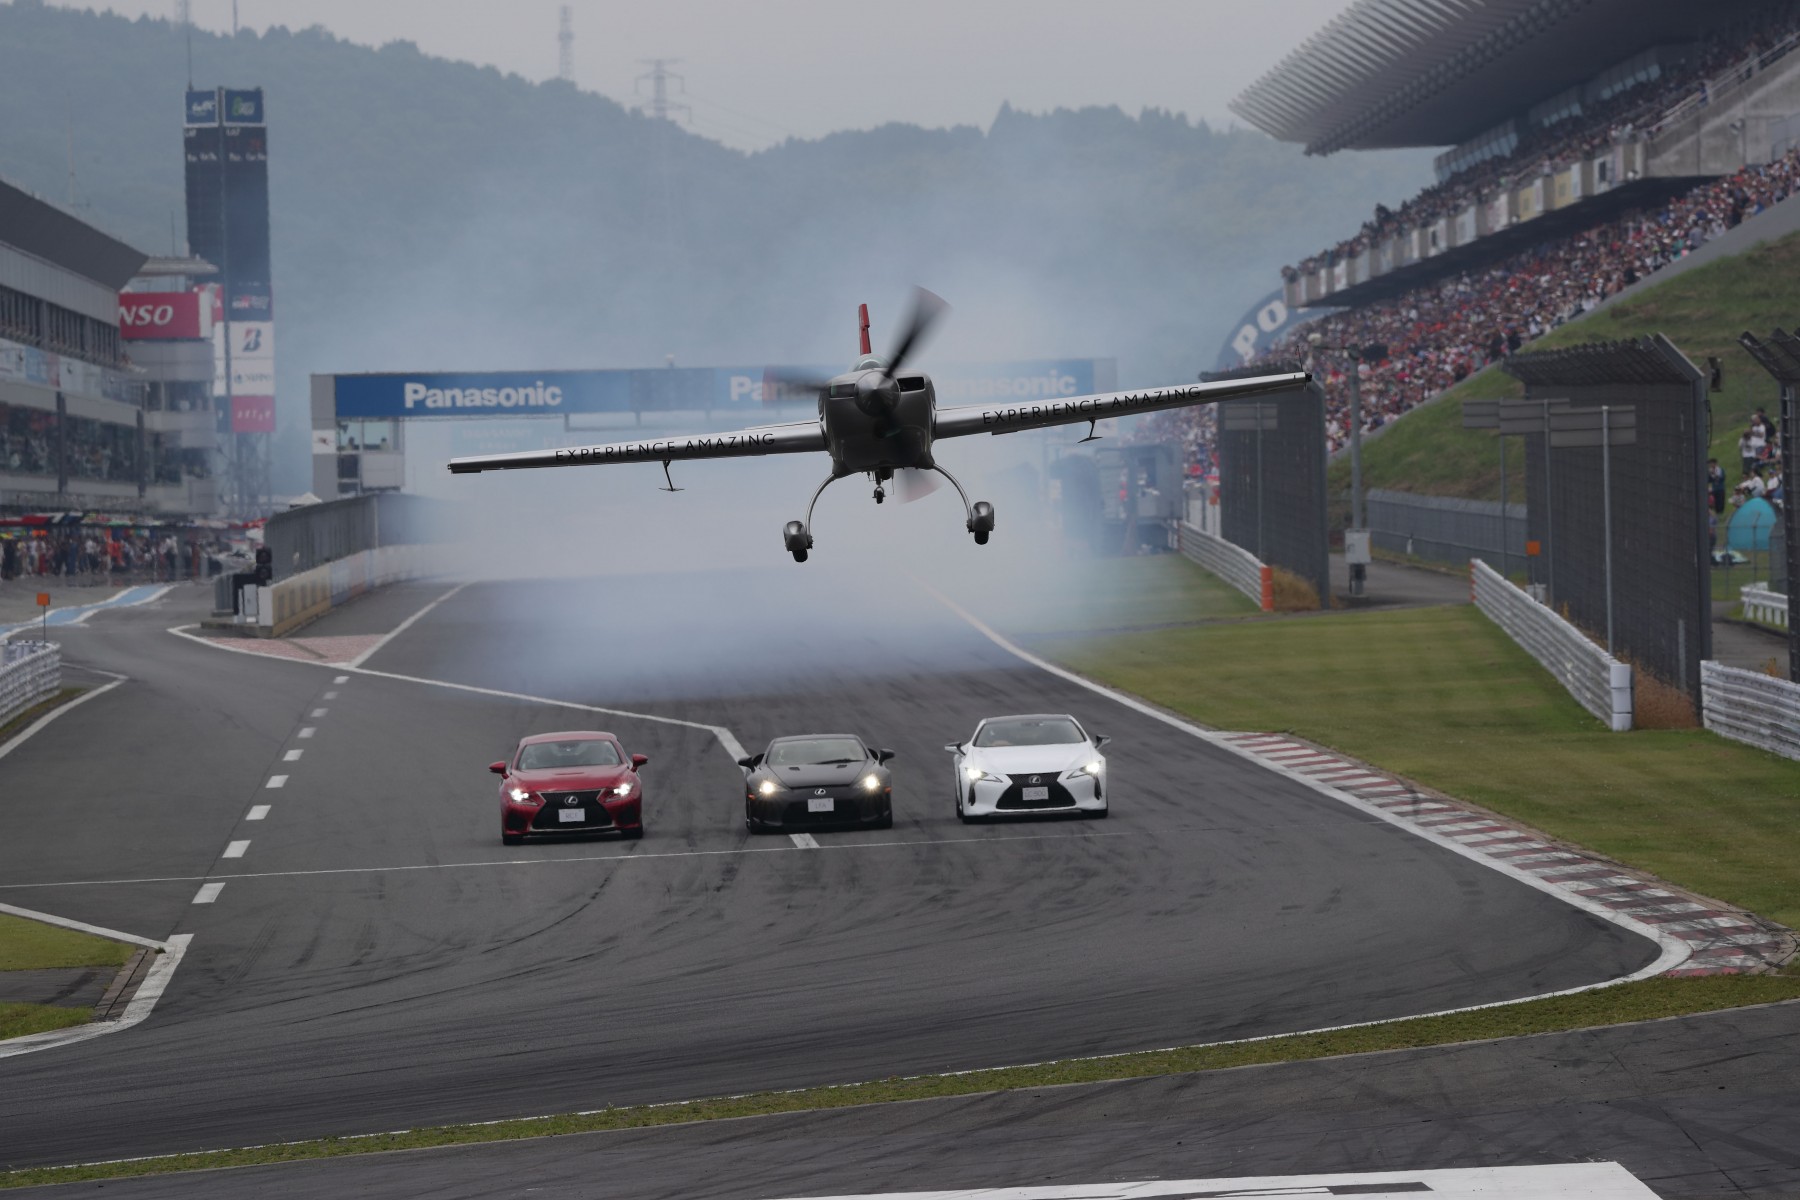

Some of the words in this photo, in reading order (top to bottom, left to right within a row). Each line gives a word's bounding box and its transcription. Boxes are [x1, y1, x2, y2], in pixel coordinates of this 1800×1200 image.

[404, 381, 562, 408] Panasonic
[983, 398, 1103, 424] EXPERIENCE
[1111, 386, 1201, 409] AMAZING
[555, 441, 676, 461] EXPERIENCE
[685, 433, 776, 451] AMAZING
